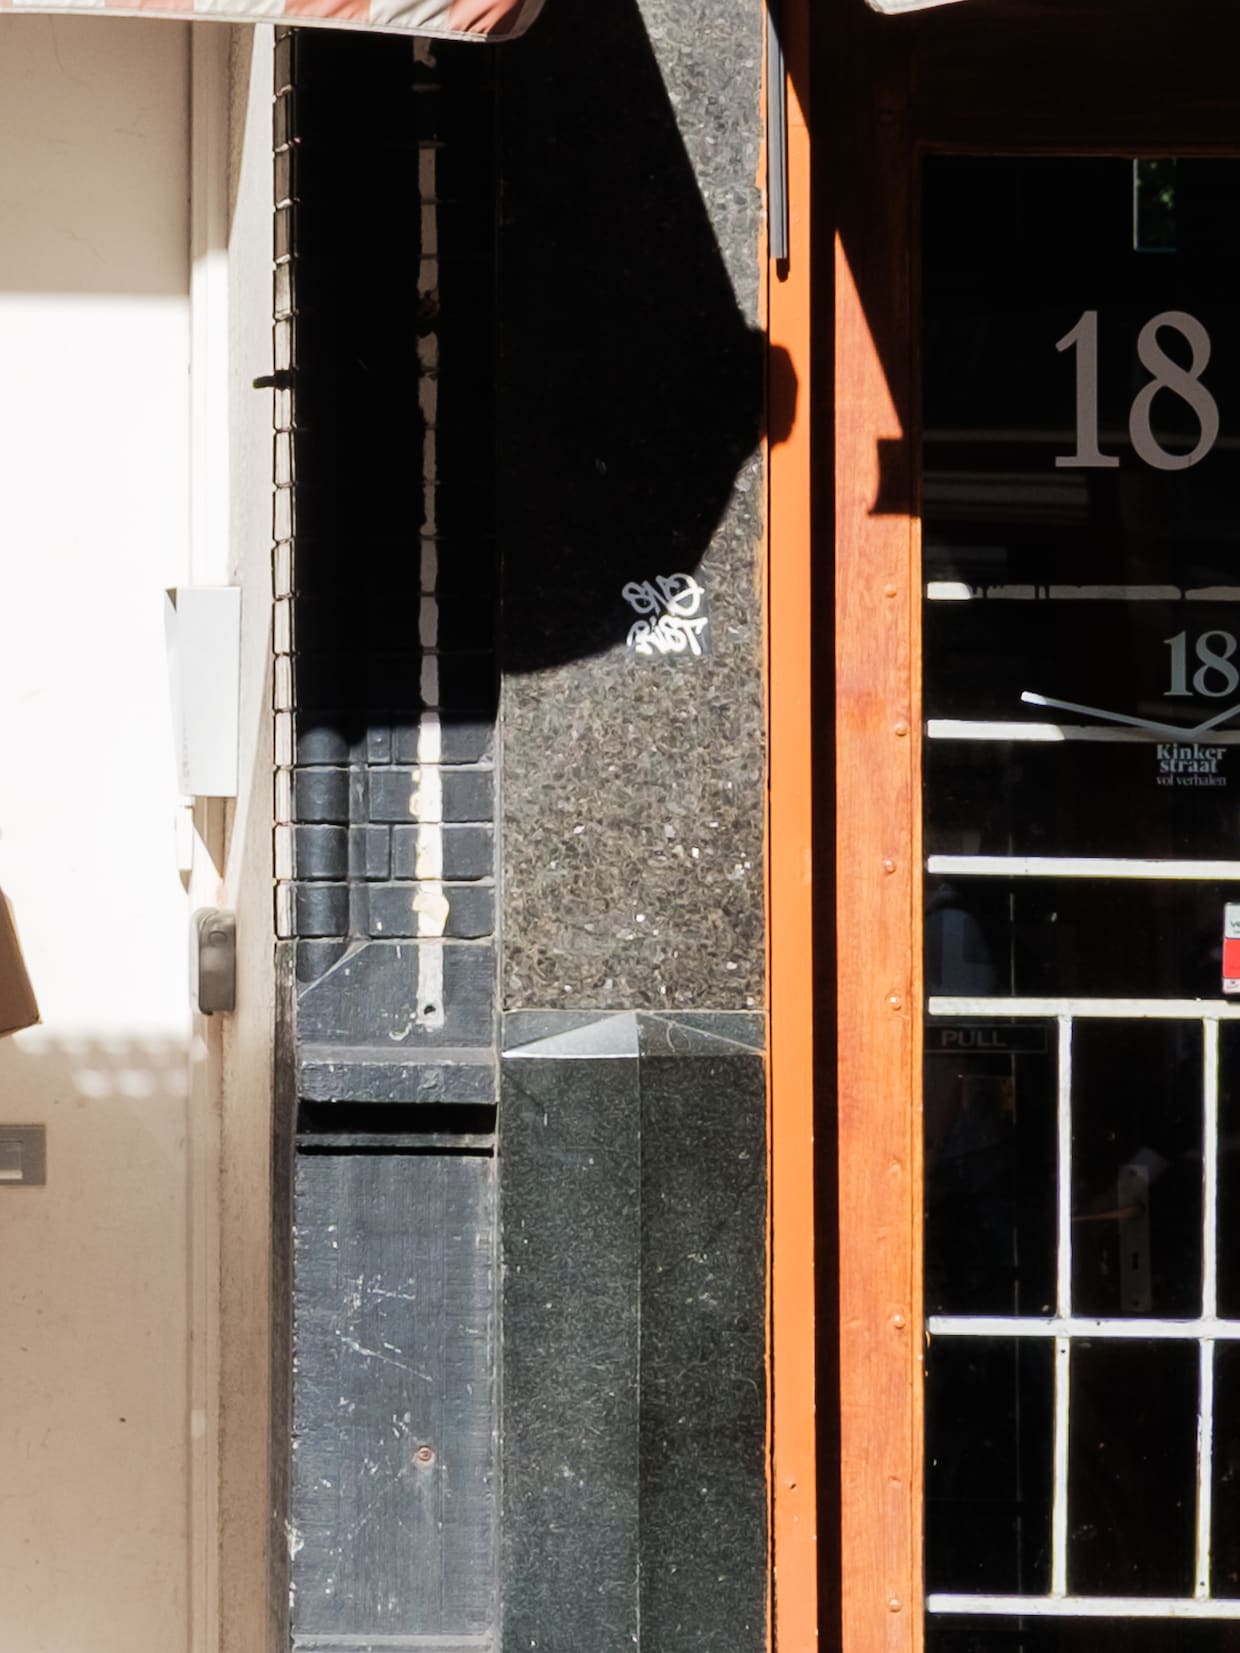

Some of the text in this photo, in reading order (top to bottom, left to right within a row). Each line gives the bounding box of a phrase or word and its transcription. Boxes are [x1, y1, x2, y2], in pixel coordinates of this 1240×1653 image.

[1055, 310, 1219, 471] 18
[1163, 630, 1240, 697] 18
[1156, 743, 1227, 760] Kinker
[1159, 758, 1218, 773] straat
[1156, 774, 1228, 787] vol verhalen
[941, 1029, 1008, 1048] PULL
